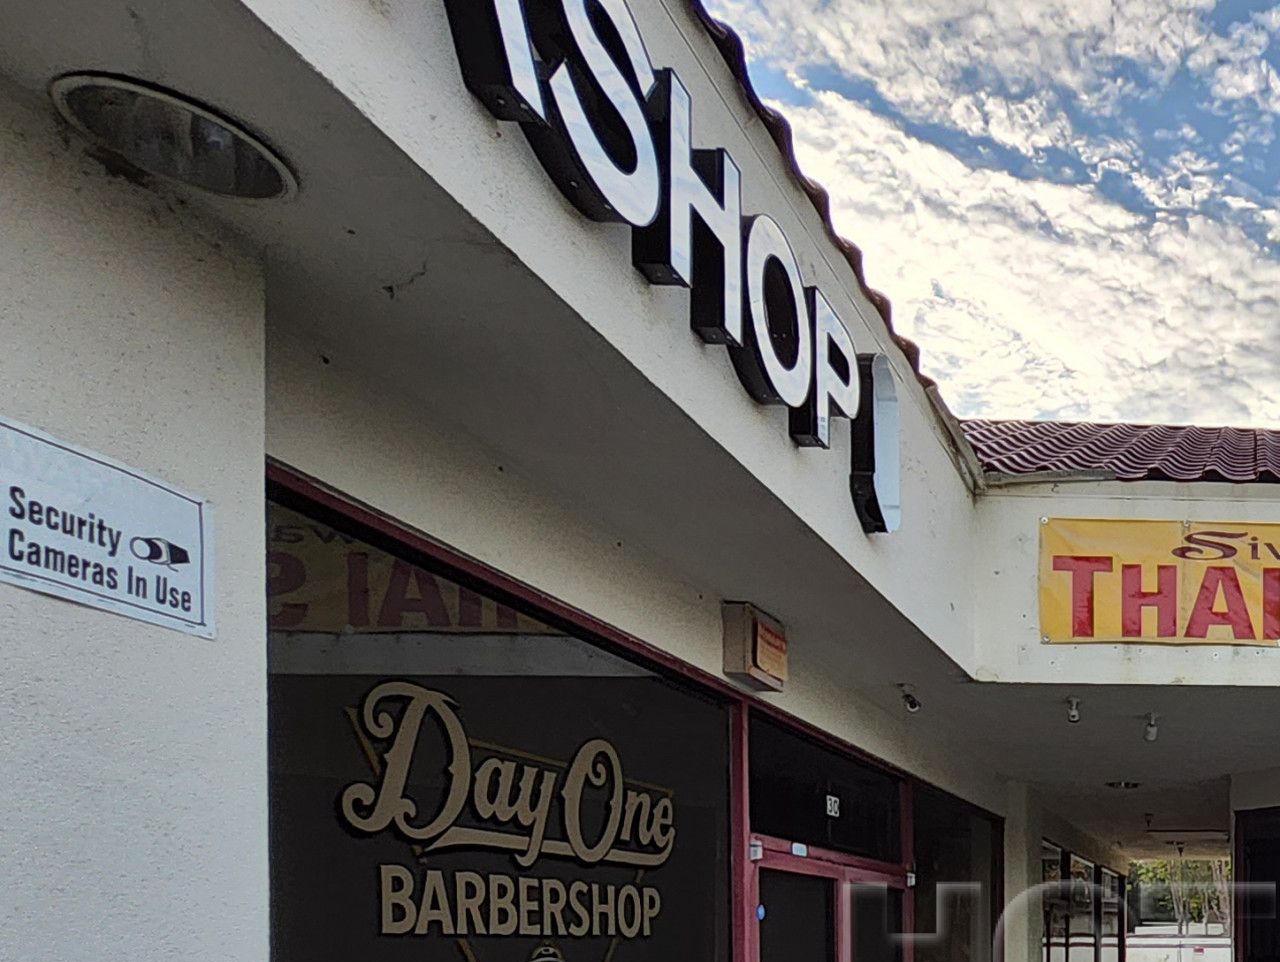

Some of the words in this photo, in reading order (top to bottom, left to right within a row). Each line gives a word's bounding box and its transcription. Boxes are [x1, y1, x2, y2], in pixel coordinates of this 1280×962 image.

[8, 485, 122, 557] Security
[8, 527, 118, 590] Cameras
[127, 565, 148, 599] In
[155, 574, 192, 612] Use
[341, 681, 557, 867] Day
[561, 738, 676, 866] One
[380, 864, 661, 938] BARBERSHOP
